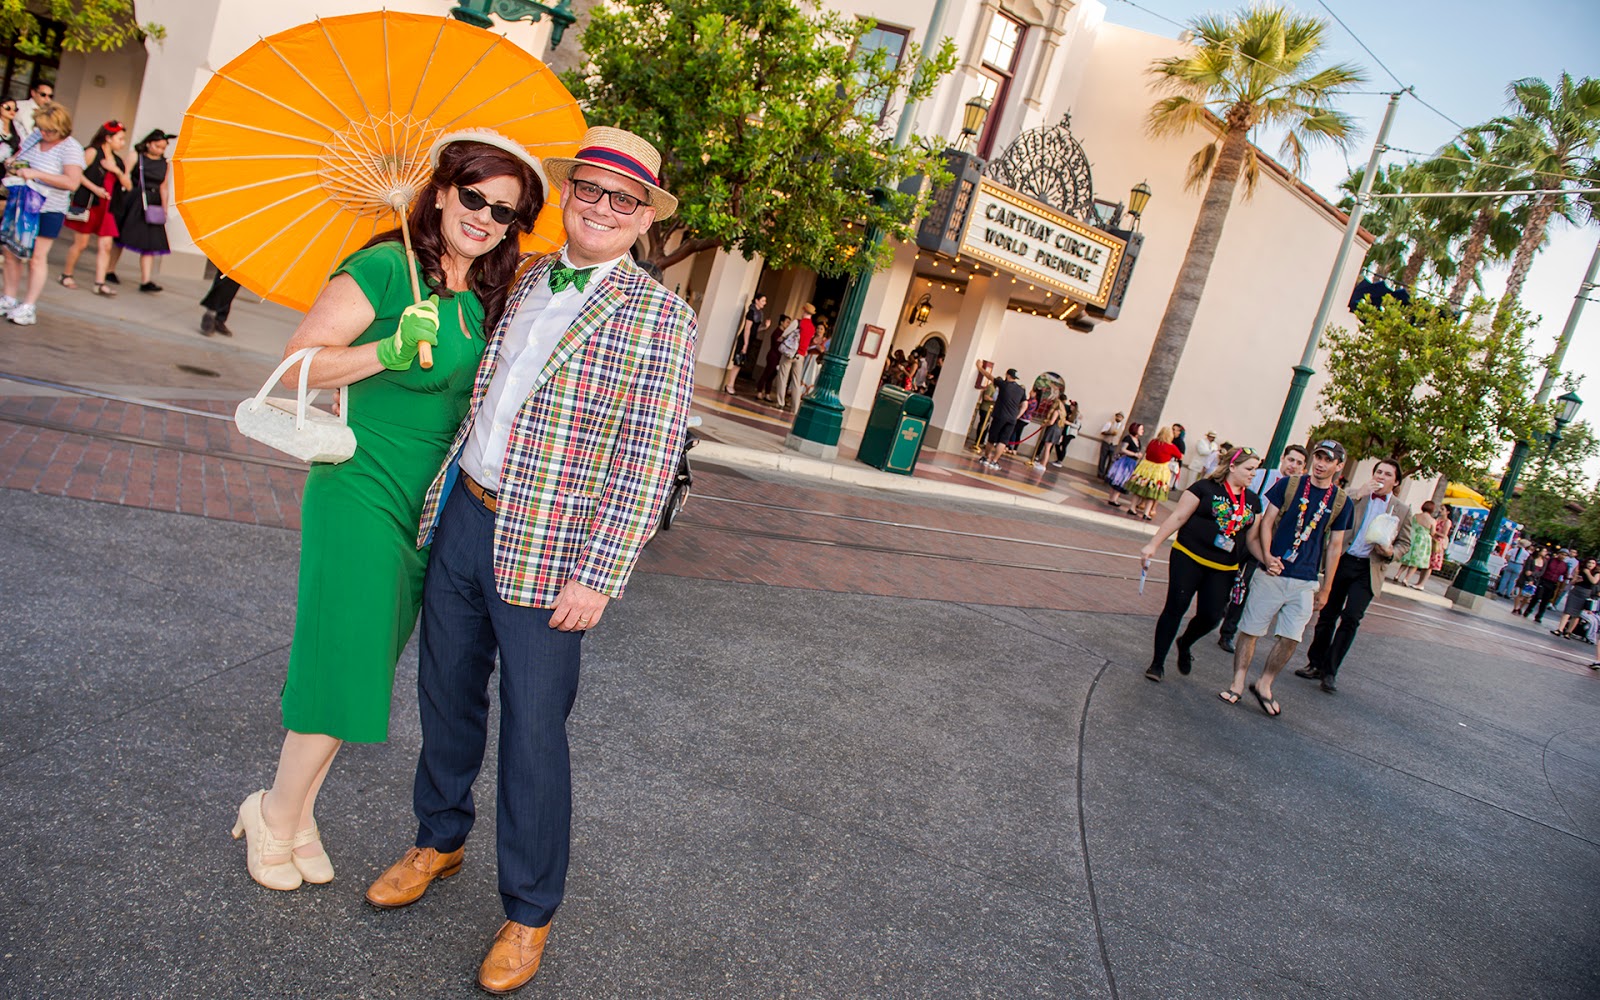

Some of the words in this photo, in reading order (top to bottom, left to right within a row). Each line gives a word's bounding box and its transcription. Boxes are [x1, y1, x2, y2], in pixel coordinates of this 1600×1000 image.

[985, 228, 1028, 256] WORLD
[986, 203, 1054, 243] CARTHAY
[1055, 234, 1102, 265] CIRCLE
